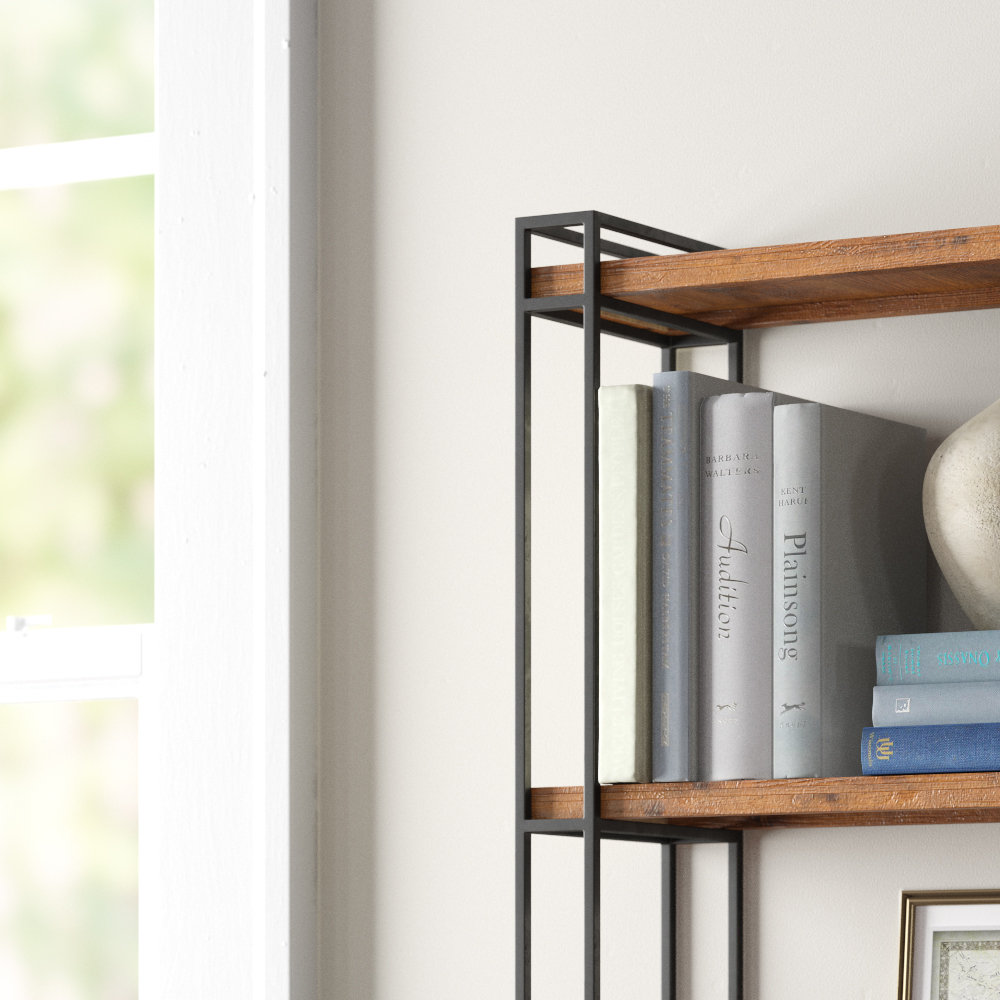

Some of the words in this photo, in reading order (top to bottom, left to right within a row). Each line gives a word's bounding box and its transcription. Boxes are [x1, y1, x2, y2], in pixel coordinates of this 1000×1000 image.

[705, 468, 761, 478] WALTERS
[716, 514, 748, 641] Audition
[777, 531, 808, 662] Plainsong
[936, 650, 990, 668] ONASSIS
